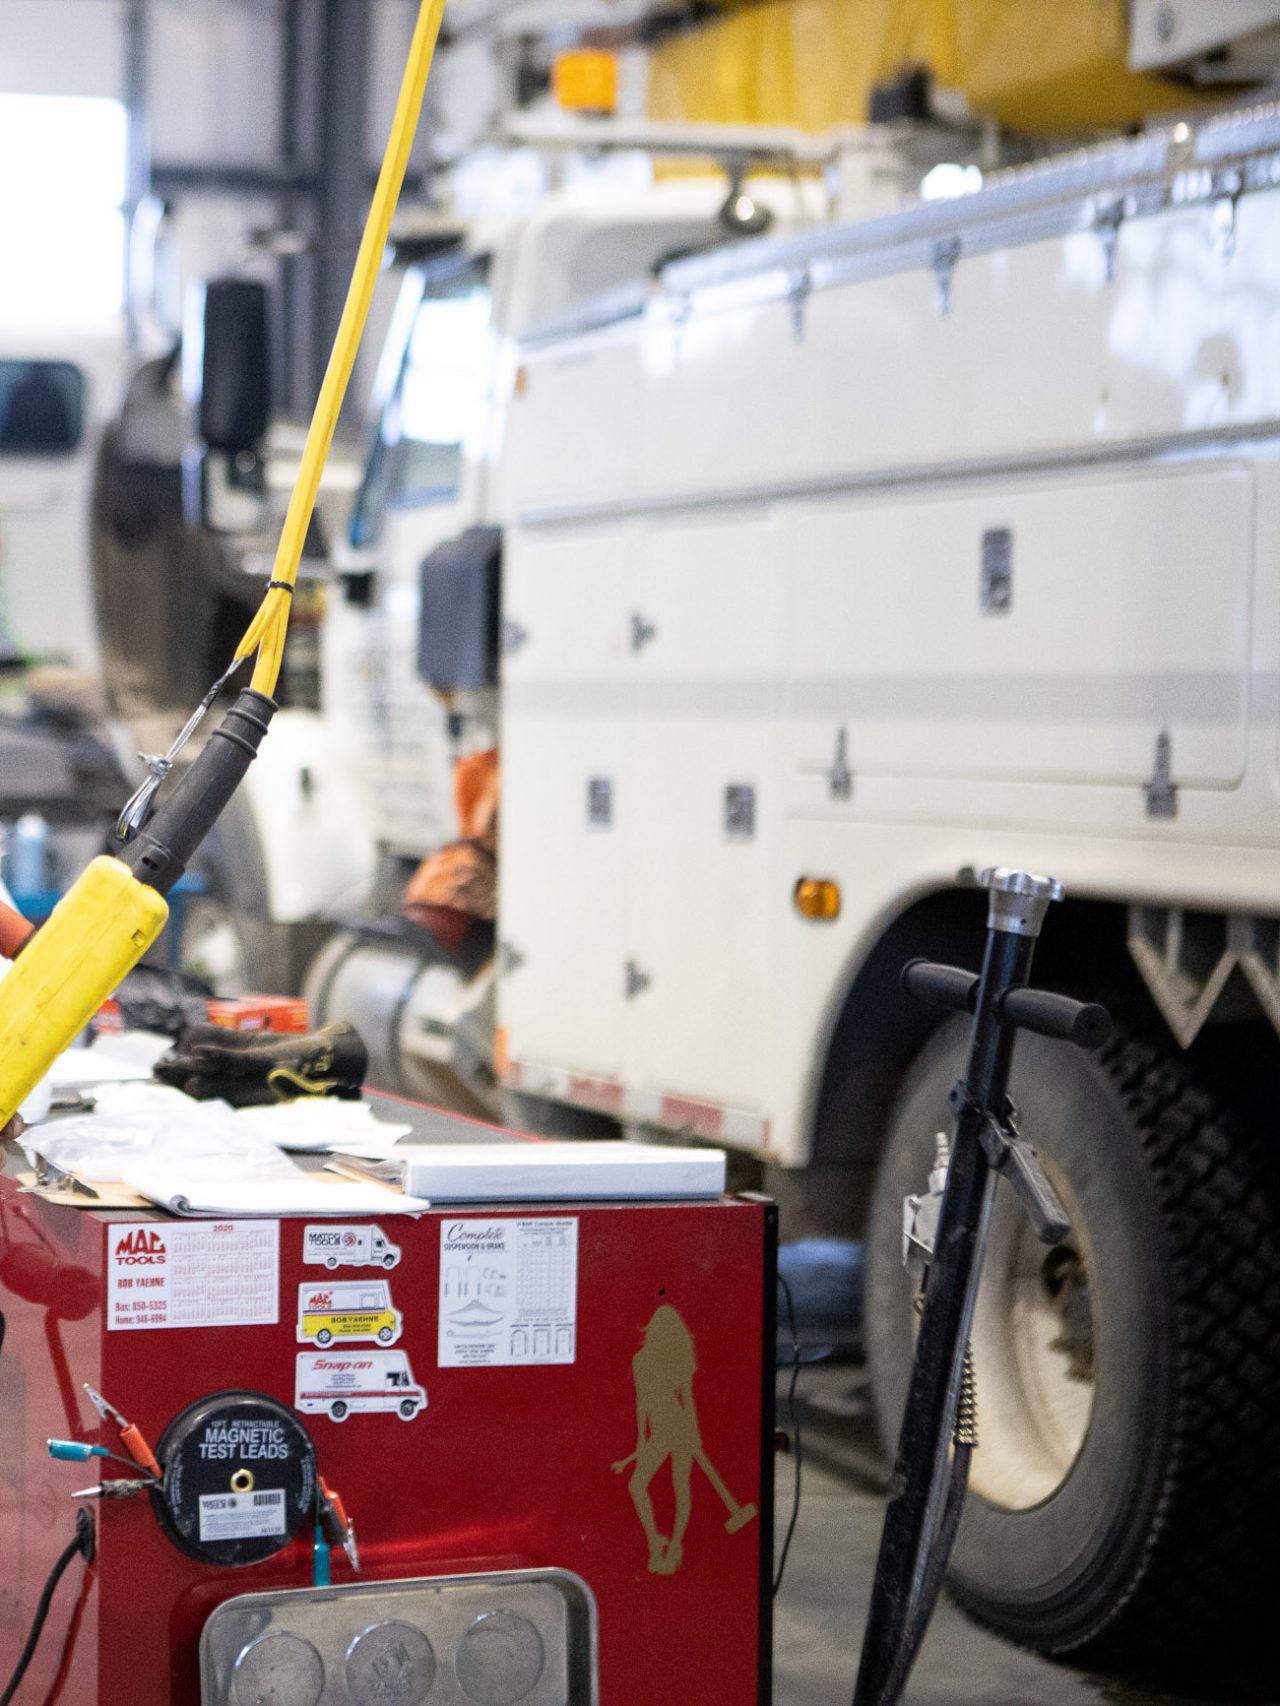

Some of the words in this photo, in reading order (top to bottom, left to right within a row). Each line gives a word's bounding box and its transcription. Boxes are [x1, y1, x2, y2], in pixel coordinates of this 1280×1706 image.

[447, 1223, 504, 1242] Complete
[115, 1229, 166, 1255] MAC
[115, 1255, 166, 1265] TOOLS
[312, 1359, 373, 1371] Snap-on
[205, 1428, 284, 1443] MAGNETIC
[199, 1444, 237, 1459] TEST
[240, 1444, 289, 1459] LEADS
